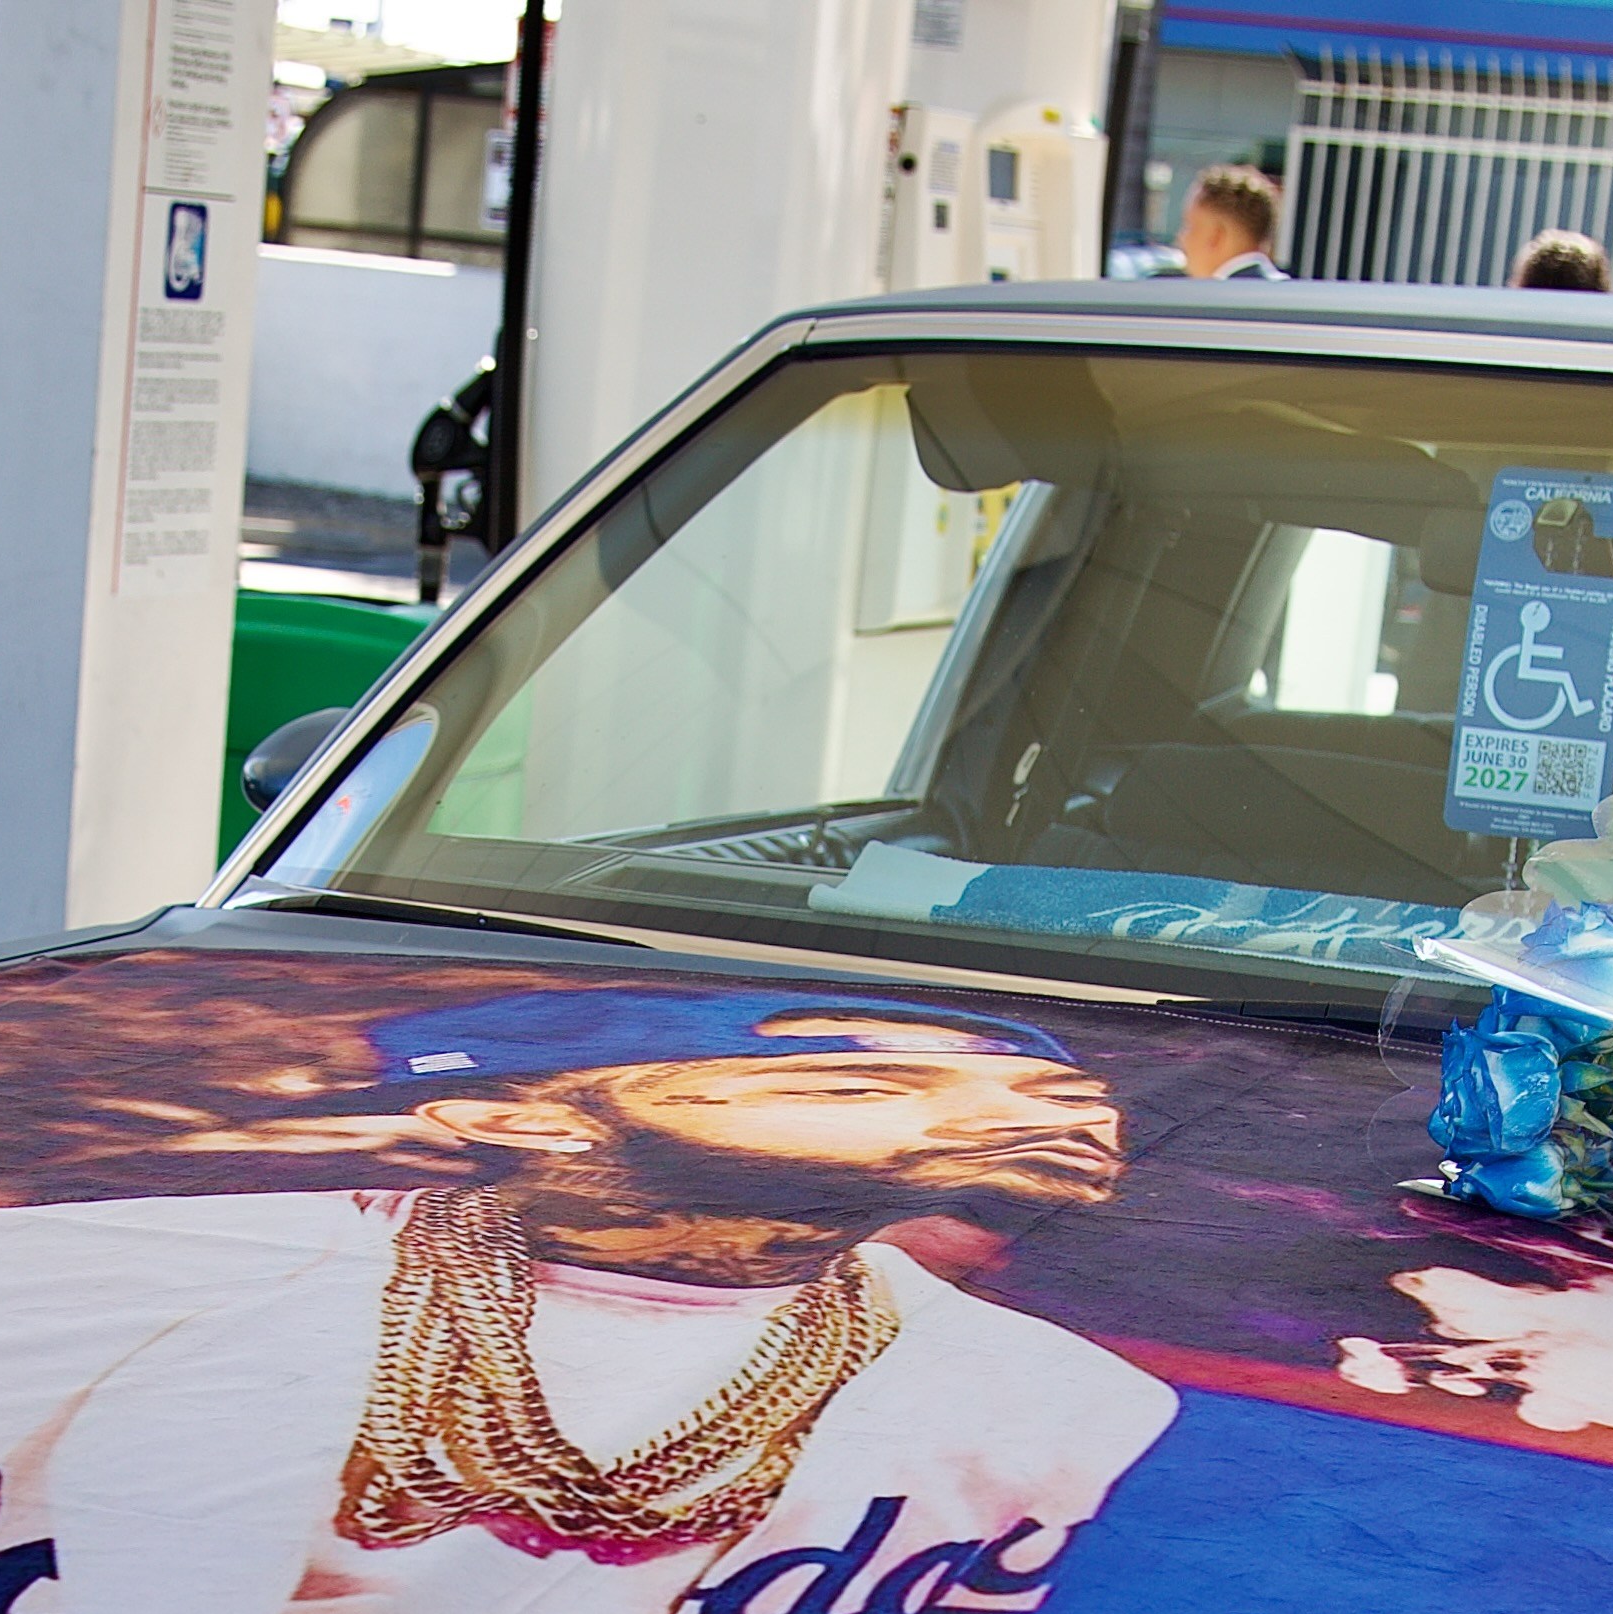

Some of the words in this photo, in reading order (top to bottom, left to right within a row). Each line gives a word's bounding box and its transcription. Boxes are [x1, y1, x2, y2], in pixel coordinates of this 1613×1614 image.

[1525, 486, 1611, 505] CALIFORNIA
[1469, 604, 1488, 665] DISABLED
[1462, 666, 1480, 717] PERSON
[1465, 733, 1529, 754] EXPIRES
[1463, 749, 1504, 767] JUNE
[1509, 755, 1527, 768] 30
[1463, 766, 1529, 792] 2027
